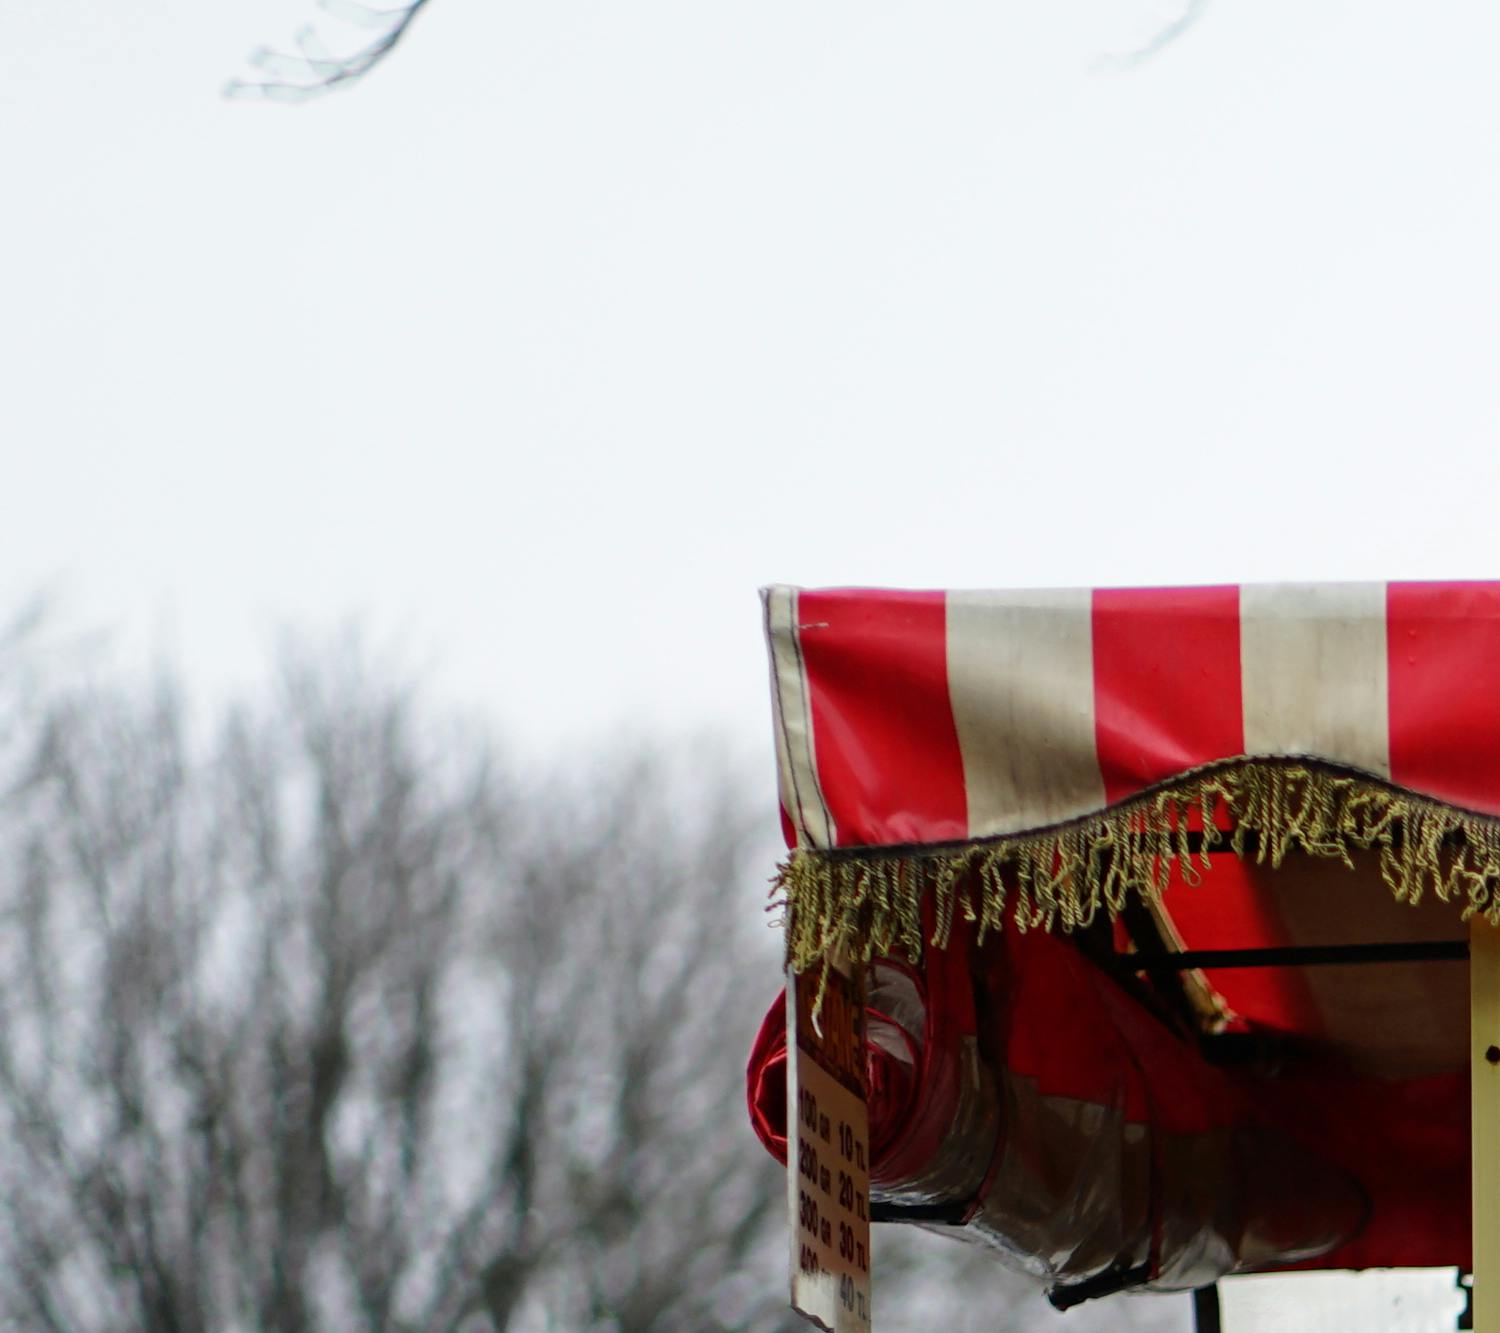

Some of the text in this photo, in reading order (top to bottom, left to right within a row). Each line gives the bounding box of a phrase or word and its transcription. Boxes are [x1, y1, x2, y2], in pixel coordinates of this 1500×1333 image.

[800, 1088, 817, 1133] 100
[839, 1120, 853, 1161] 10
[855, 1140, 866, 1170] TL
[800, 1138, 818, 1184] 200
[839, 1170, 854, 1210] 20
[856, 1192, 866, 1222] TL
[800, 1189, 819, 1237] 300
[839, 1221, 854, 1264] 30
[857, 1243, 866, 1272] TL
[840, 1272, 854, 1313] 40
[857, 1289, 867, 1321] TL
